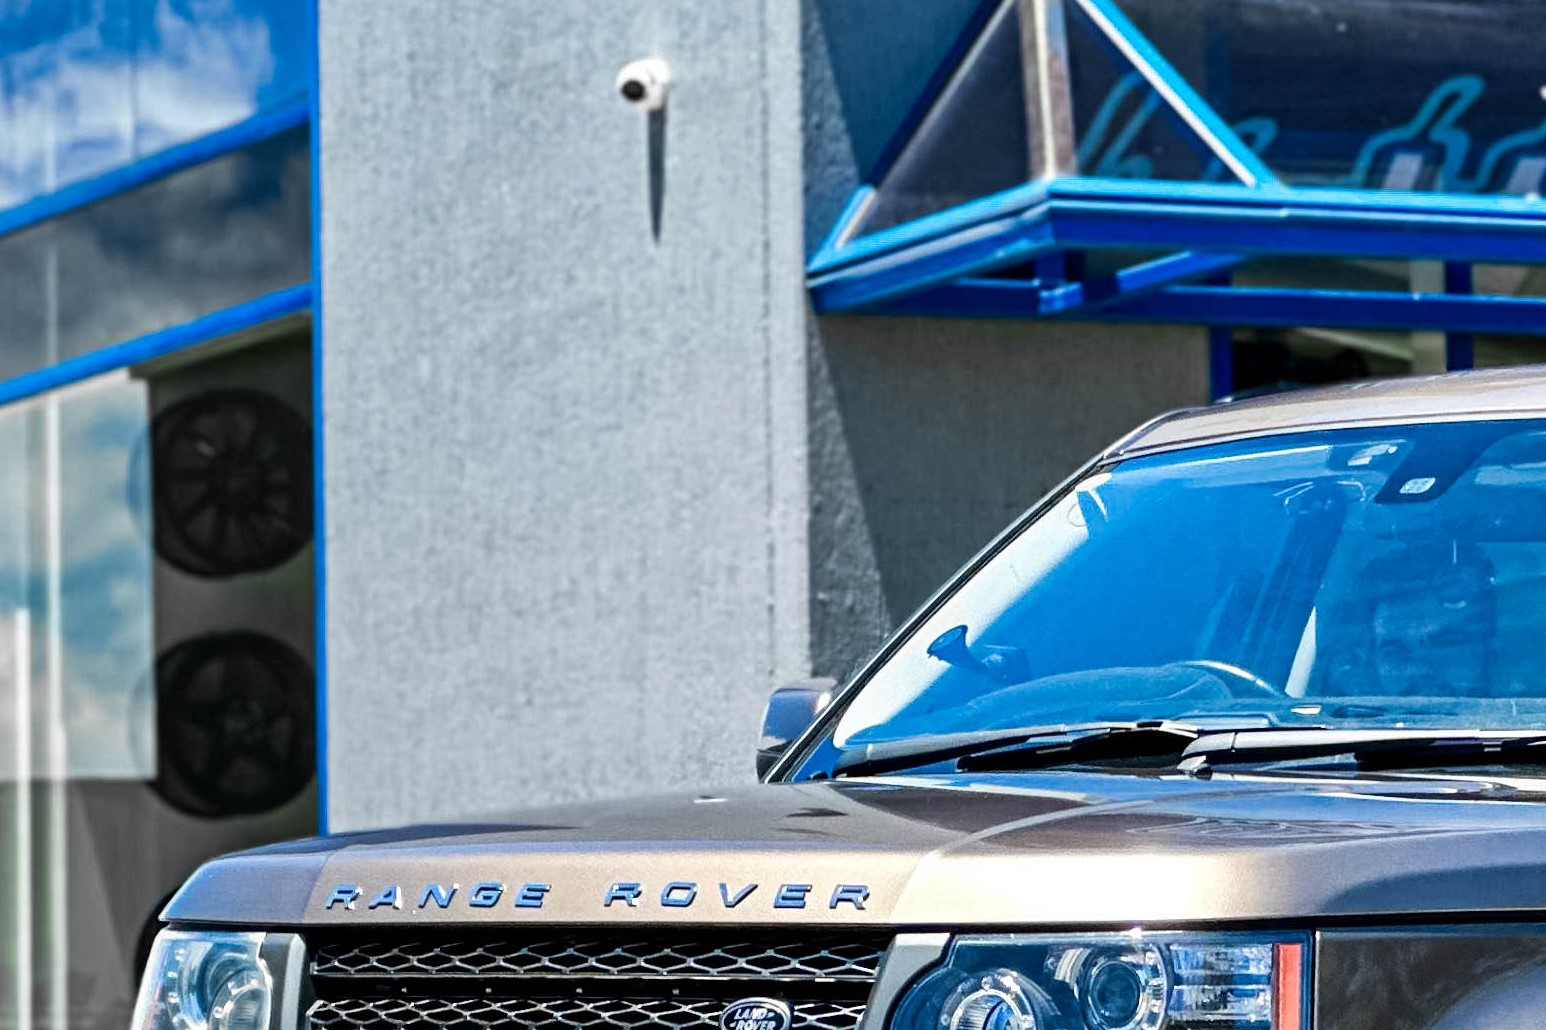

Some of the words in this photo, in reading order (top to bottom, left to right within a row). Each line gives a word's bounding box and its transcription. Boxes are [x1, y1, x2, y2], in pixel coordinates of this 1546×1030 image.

[325, 881, 552, 910] RANGE
[603, 881, 872, 911] ROVER
[733, 1007, 769, 1020] LAND
